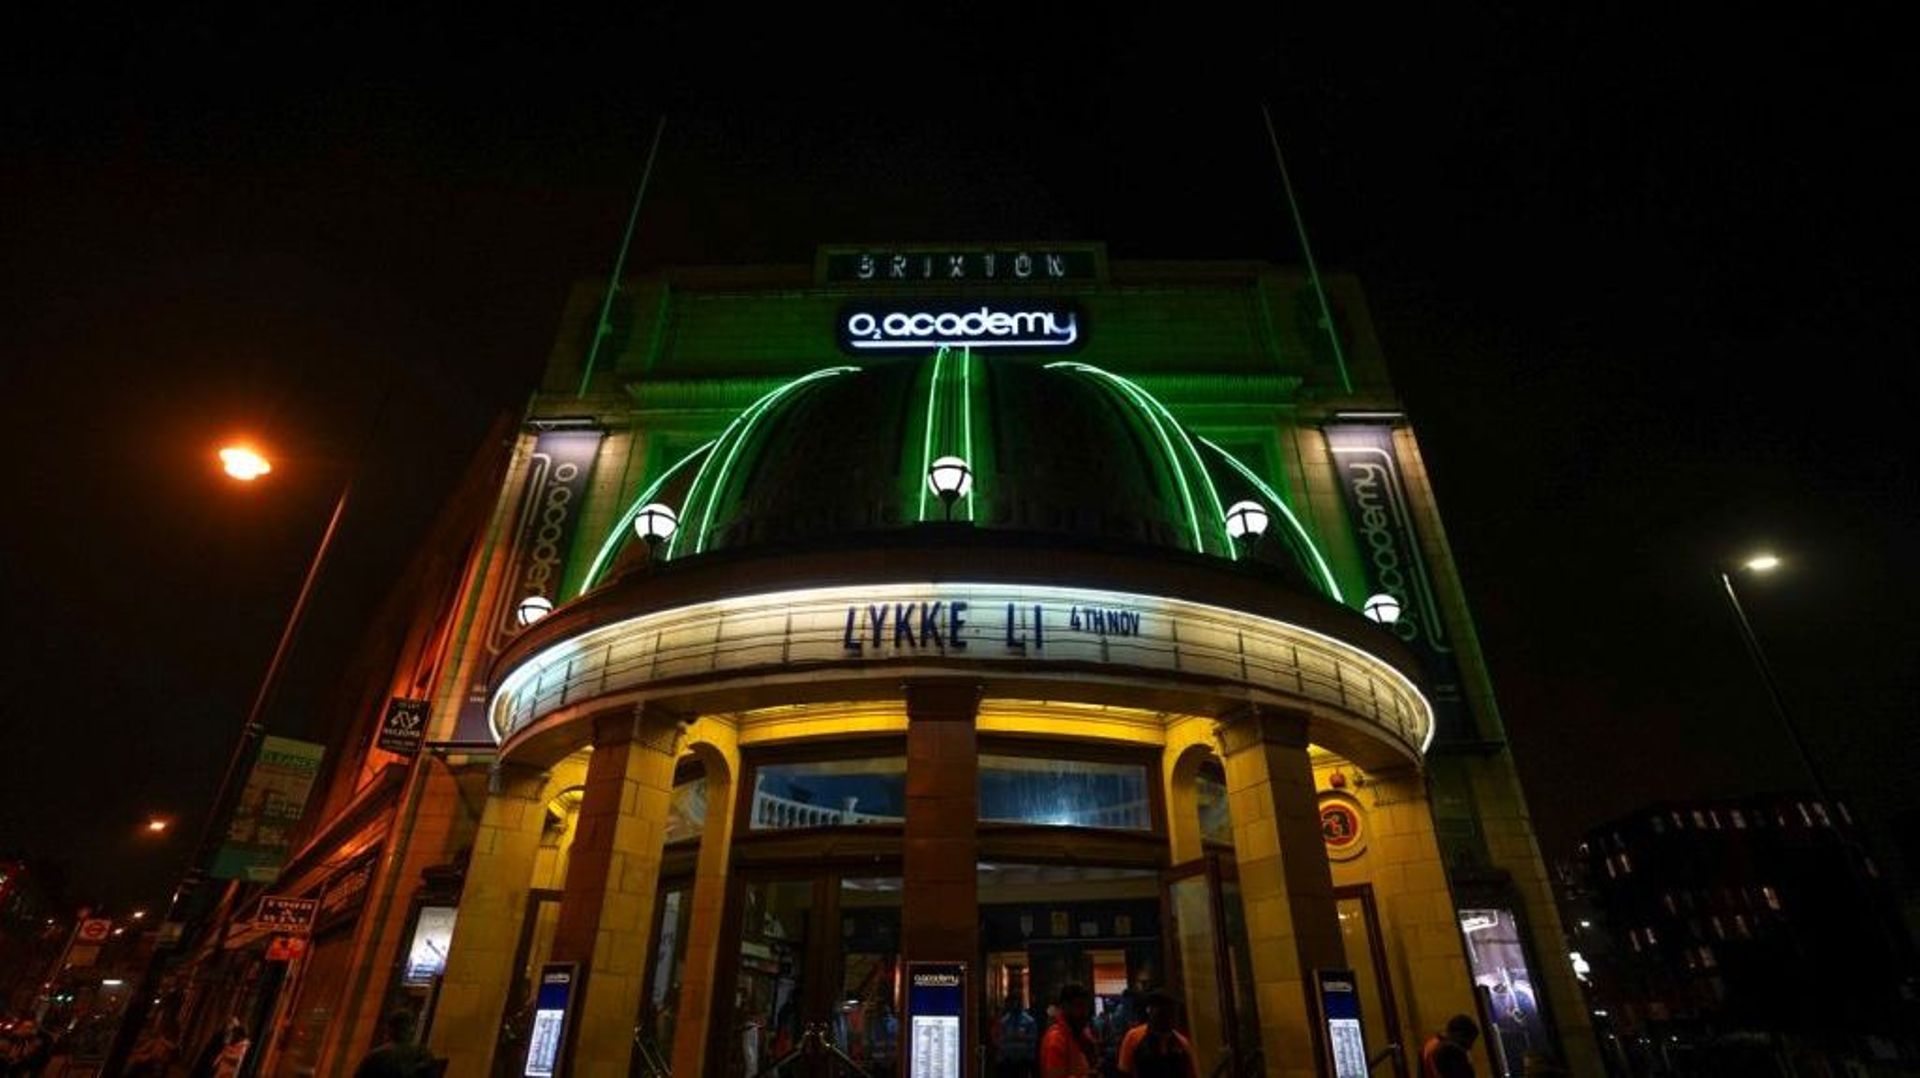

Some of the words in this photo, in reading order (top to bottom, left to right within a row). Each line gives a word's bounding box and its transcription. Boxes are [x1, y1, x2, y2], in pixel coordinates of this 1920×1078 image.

[857, 254, 1067, 279] BRIXTON
[882, 306, 1078, 346] academy
[843, 601, 968, 650] LYKKE
[1006, 603, 1043, 650] LI
